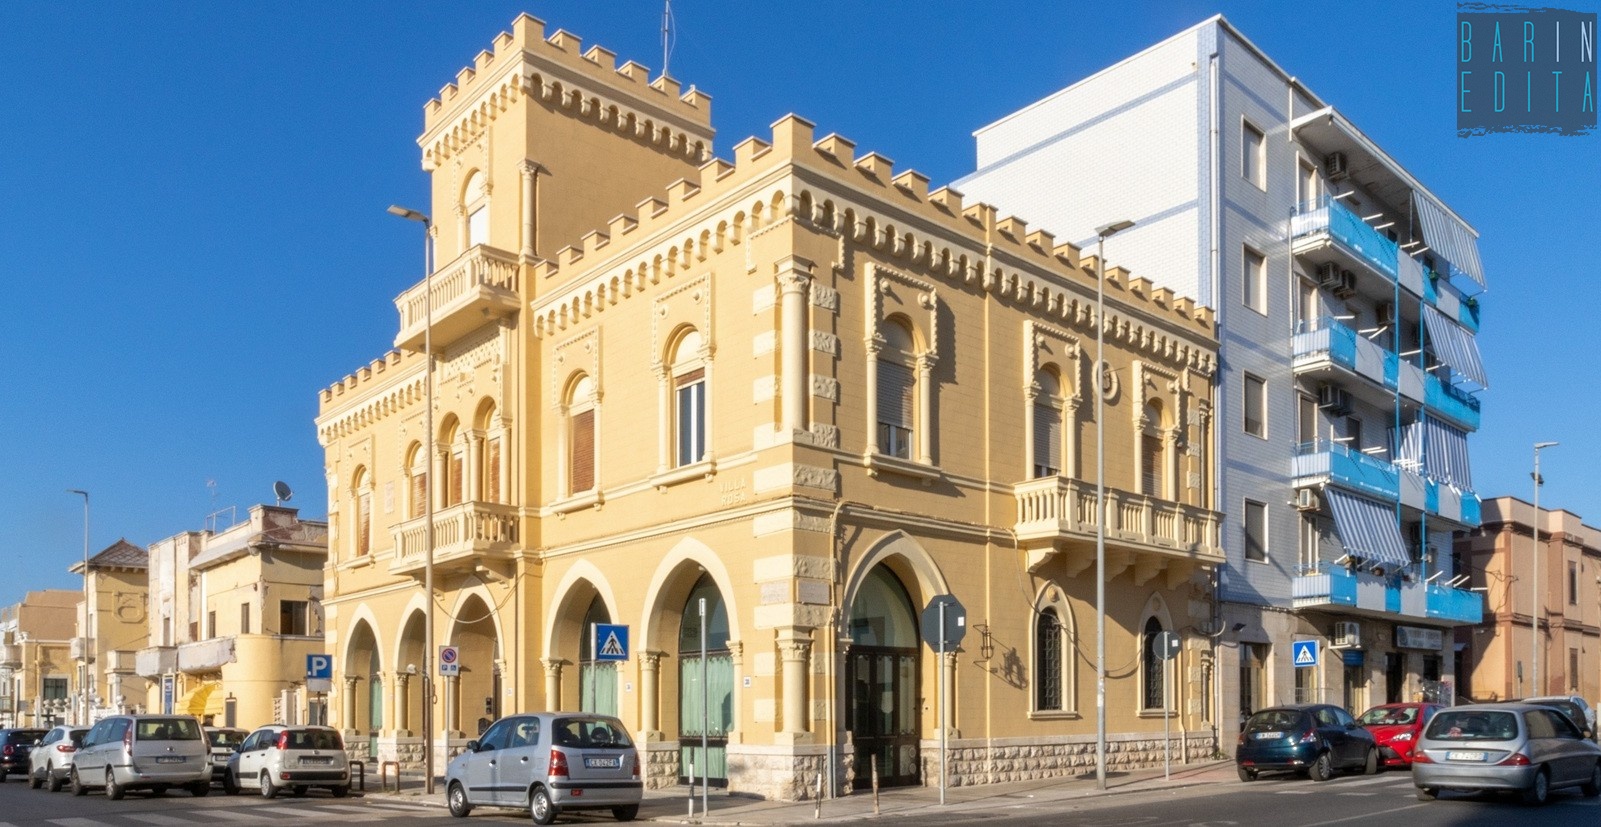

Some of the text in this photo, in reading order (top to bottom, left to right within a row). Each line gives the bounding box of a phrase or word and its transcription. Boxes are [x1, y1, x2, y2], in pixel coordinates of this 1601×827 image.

[720, 478, 747, 493] VILLA
[721, 492, 747, 506] ROSA
[312, 656, 327, 676] P
